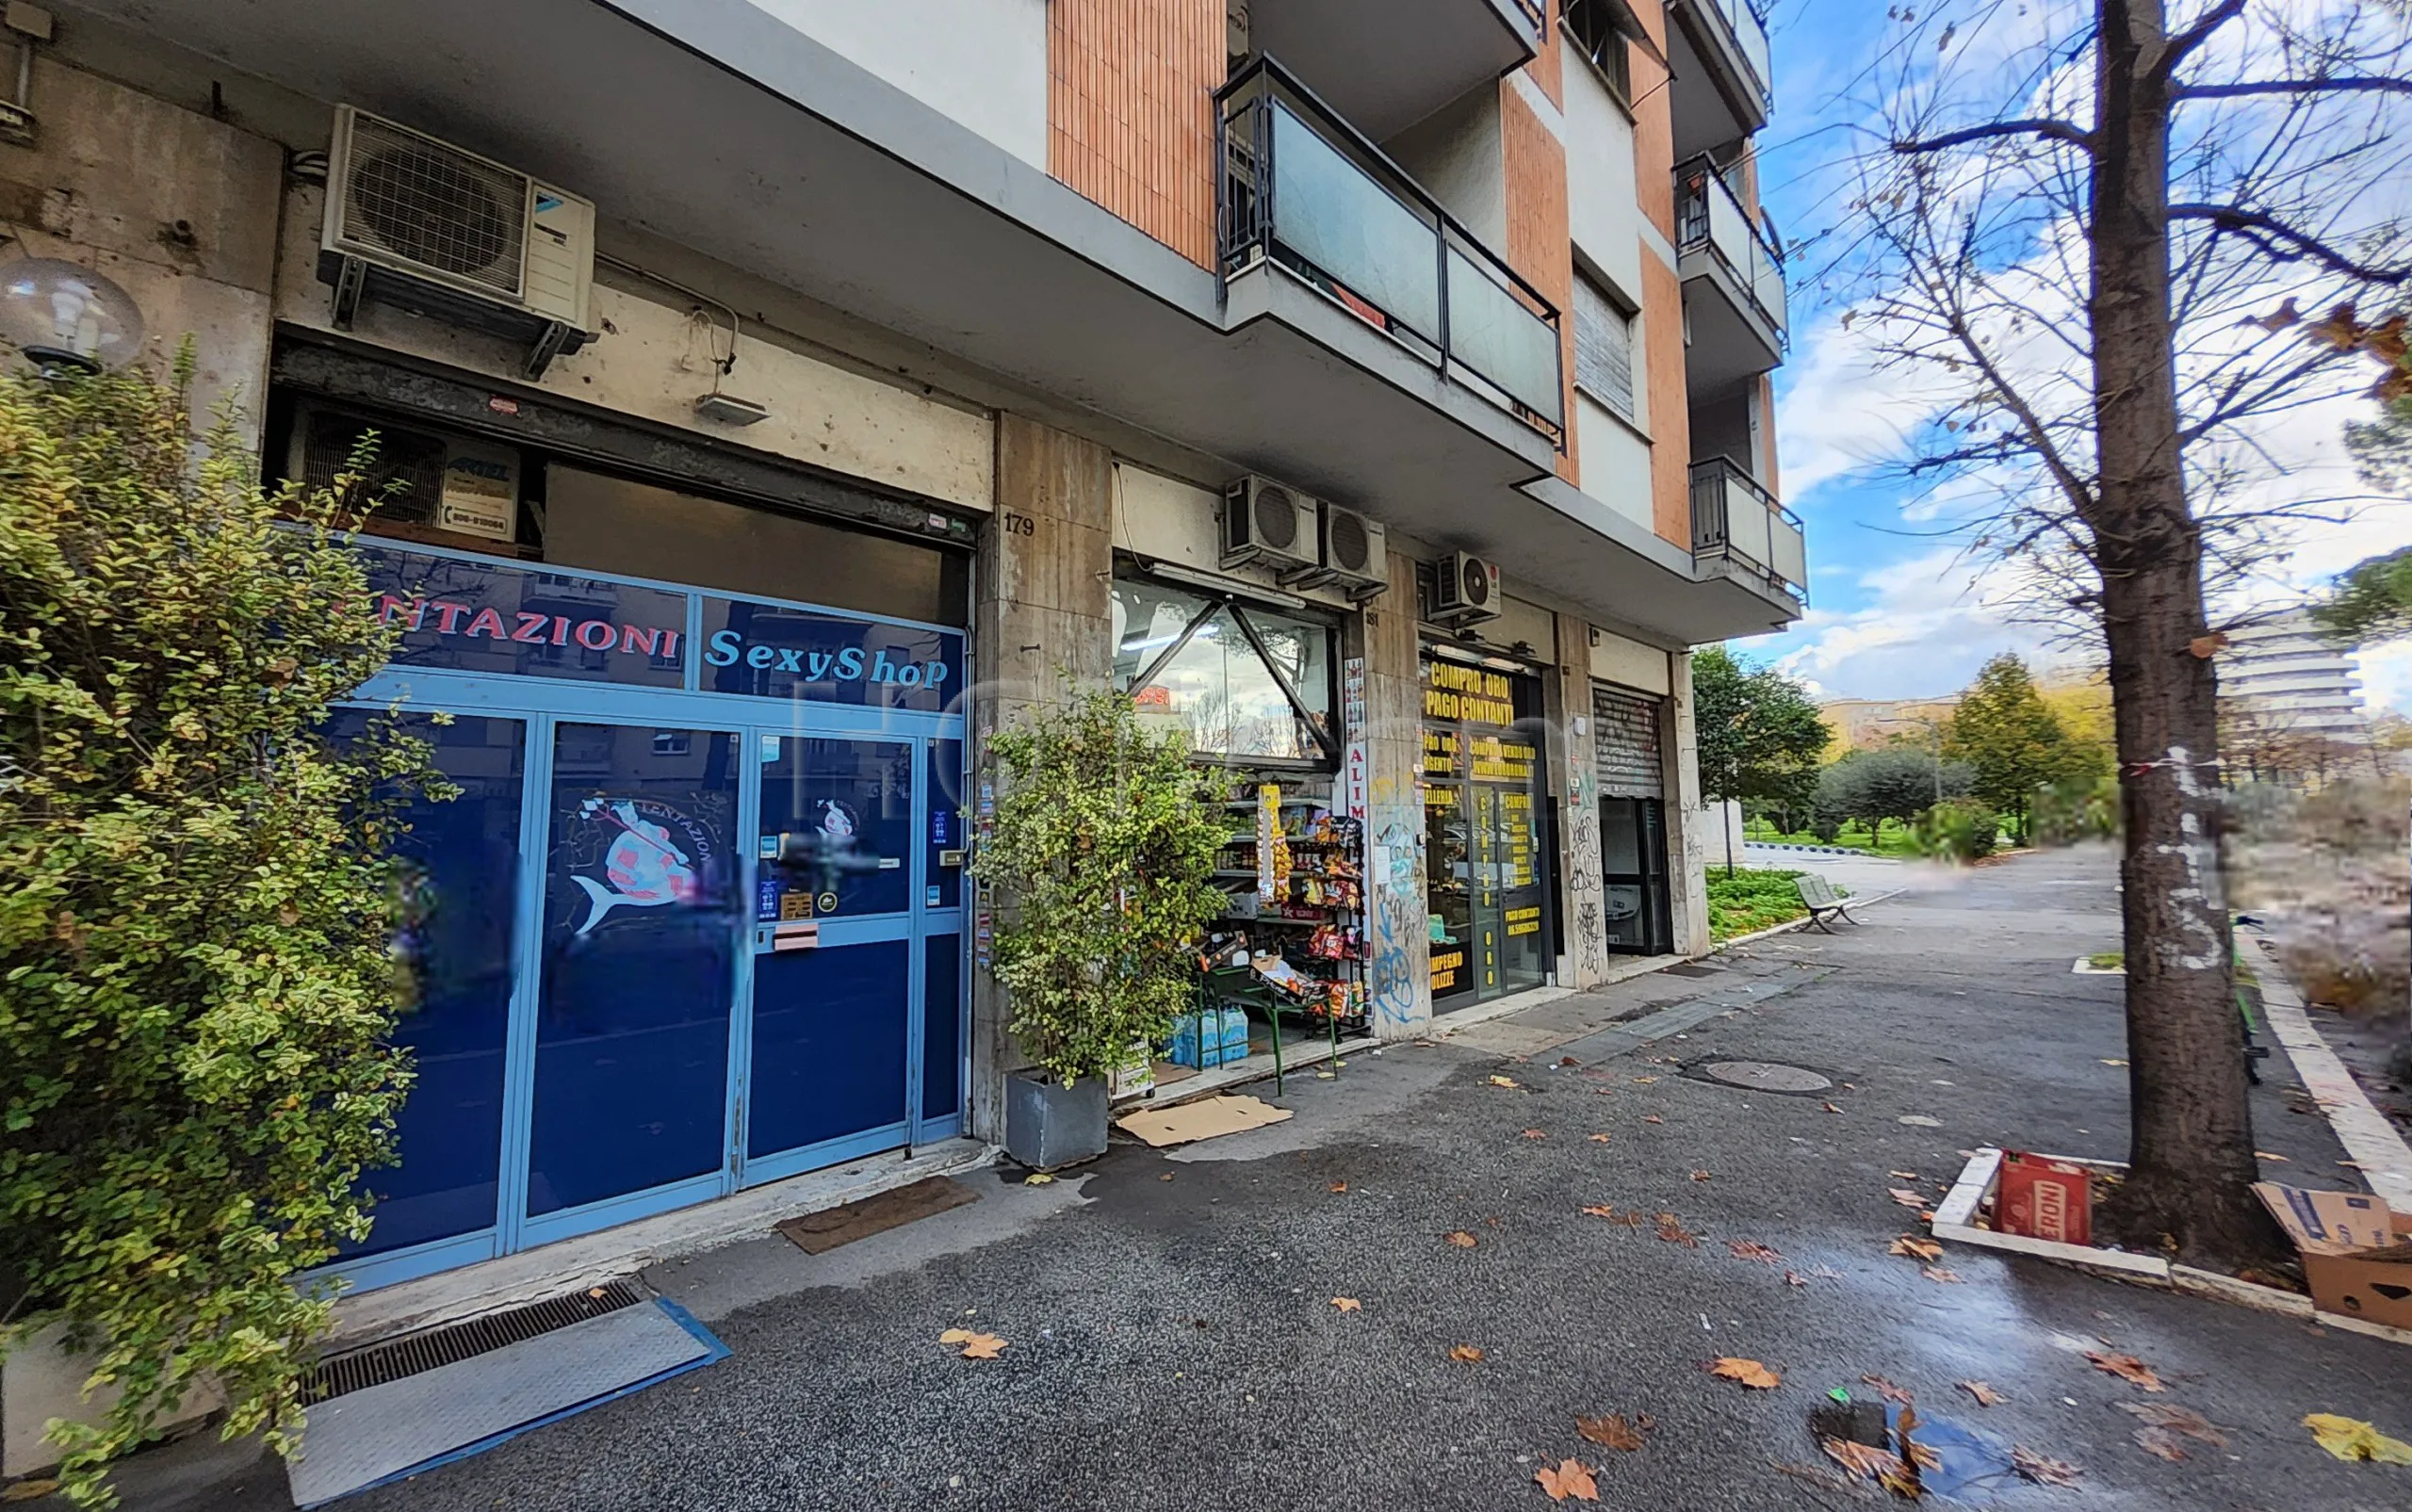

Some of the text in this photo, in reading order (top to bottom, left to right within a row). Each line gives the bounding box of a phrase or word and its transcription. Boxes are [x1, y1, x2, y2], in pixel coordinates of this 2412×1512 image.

[1004, 512, 1035, 536] 179
[375, 594, 679, 658] NTAZIONI
[1430, 661, 1508, 699] COMPRO ORO
[1426, 691, 1514, 726] PAGO CONTANTI
[1424, 735, 1457, 753] PRO ORO
[1424, 756, 1452, 772] RGENTO
[1350, 748, 1365, 820] ALIM
[1426, 789, 1454, 805] ELLERIA
[641, 801, 712, 861] TENTAZION
[1431, 970, 1455, 990] OLIZZE
[2041, 1182, 2061, 1240] ERONI
